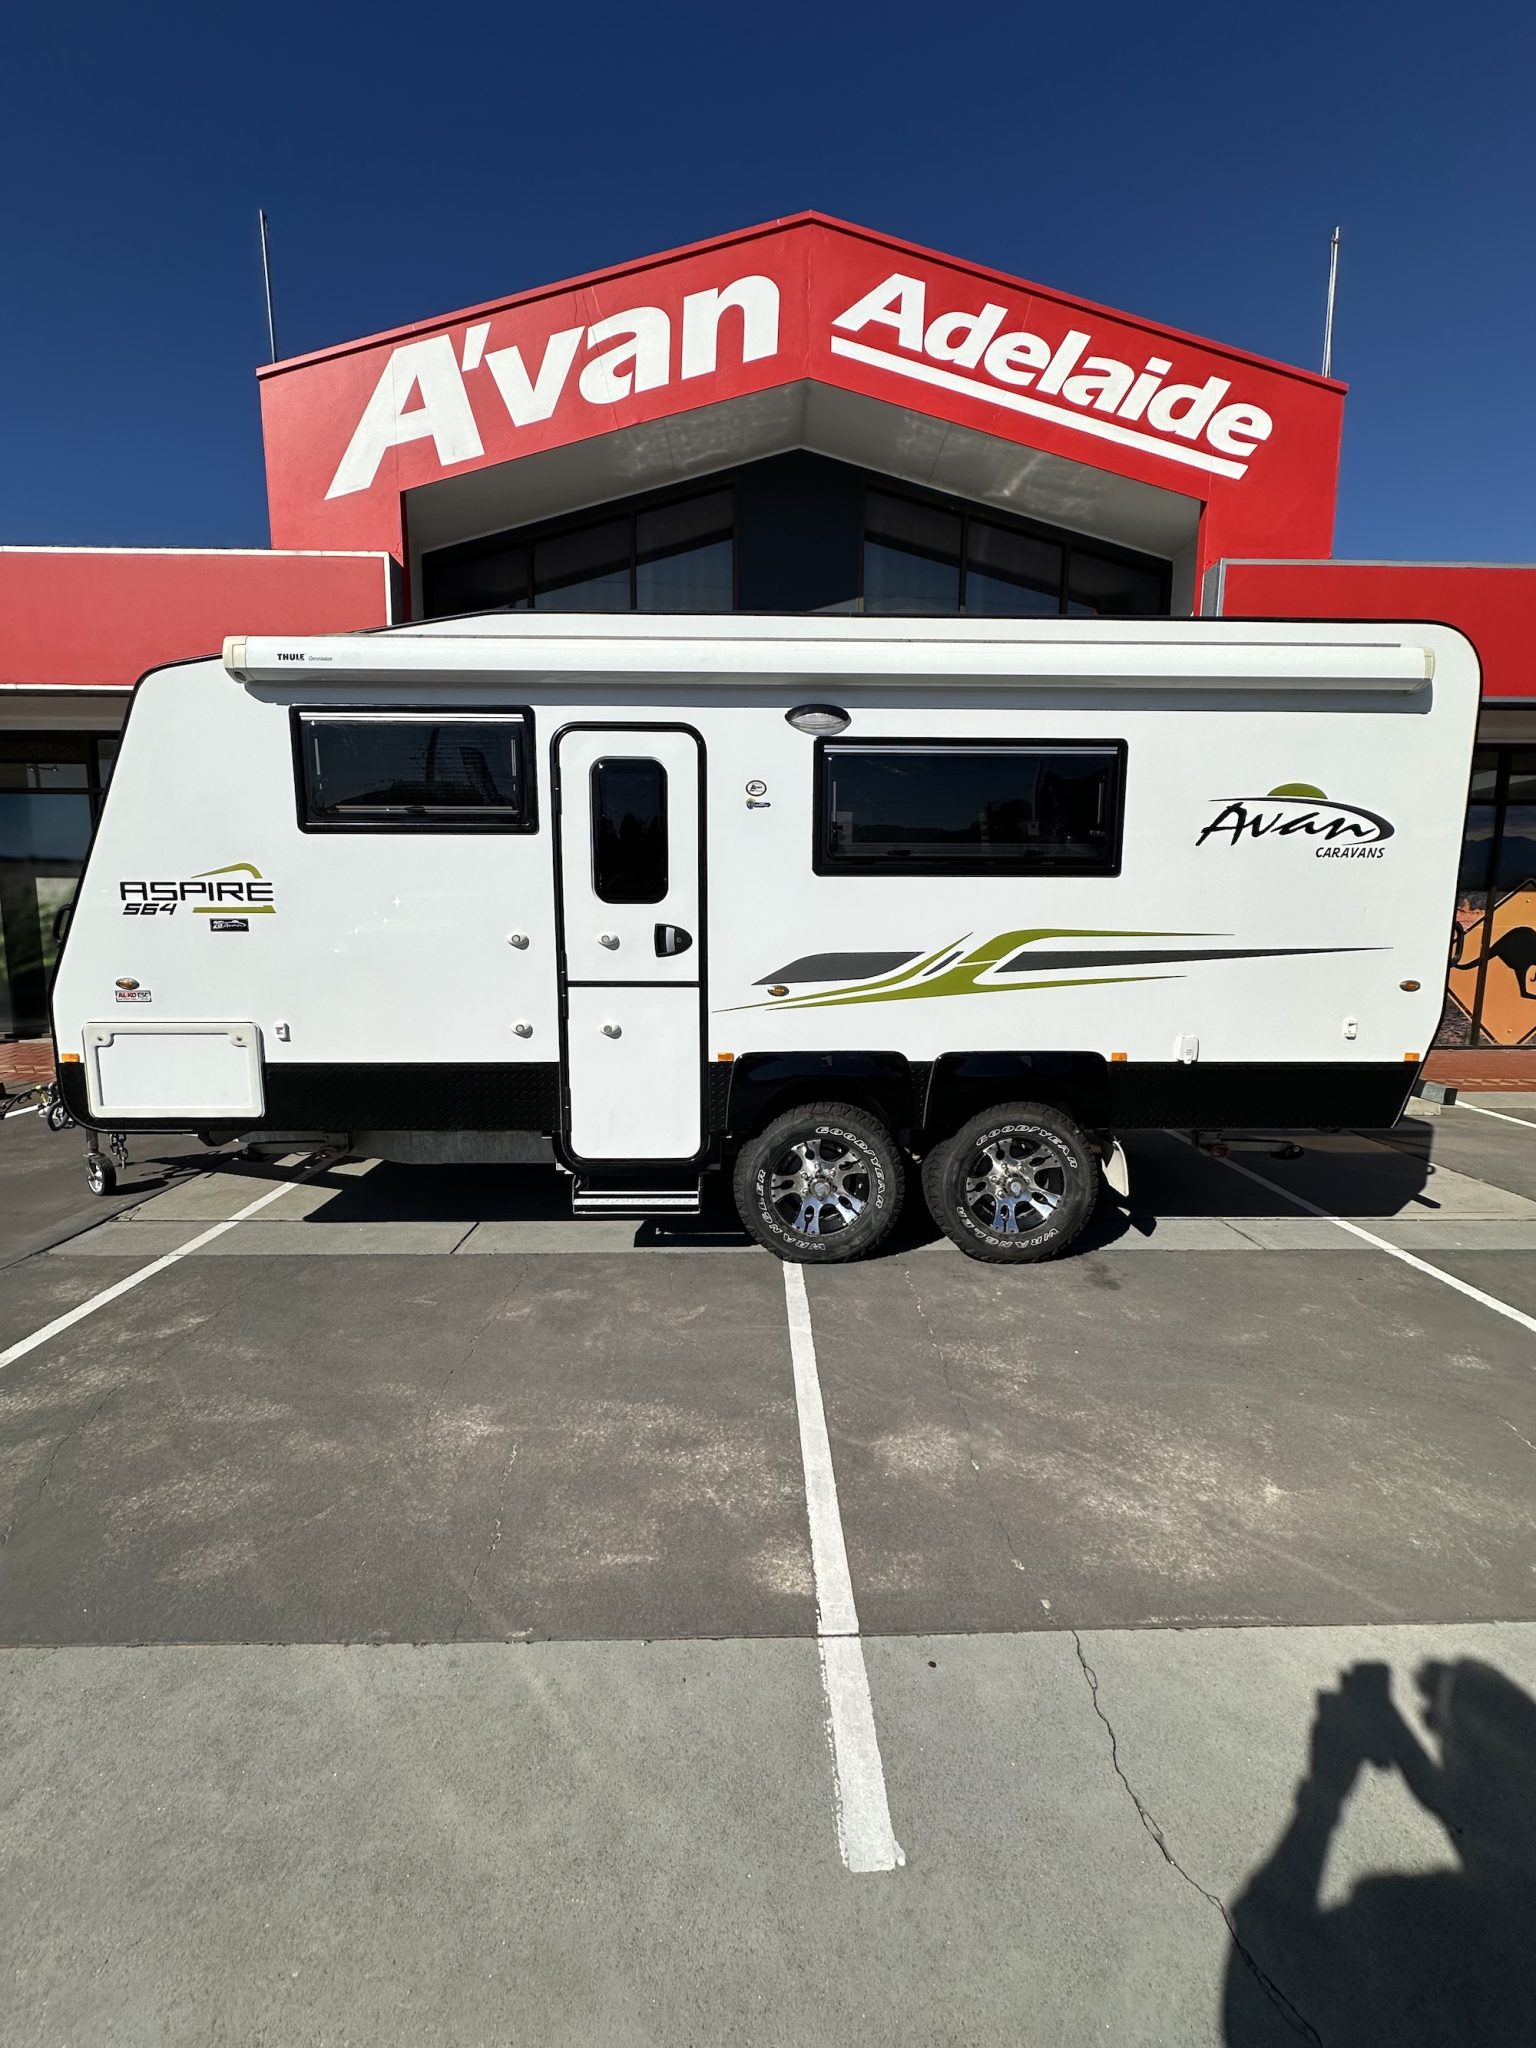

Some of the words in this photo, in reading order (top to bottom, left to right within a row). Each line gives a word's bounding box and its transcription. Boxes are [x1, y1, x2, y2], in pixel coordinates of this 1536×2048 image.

[831, 273, 1273, 457] Adelaide
[324, 275, 780, 500] A'van
[276, 653, 305, 661] THULE
[1195, 802, 1376, 846] Avan
[1315, 847, 1386, 859] CARAVANS
[119, 881, 274, 902] ASPIRE
[122, 903, 178, 916] 564
[815, 1126, 886, 1209] GOODYEAR
[976, 1124, 1078, 1169] GOODYEAR
[756, 1169, 826, 1251] WRANGLER
[957, 1206, 1059, 1249] WRANGLER
